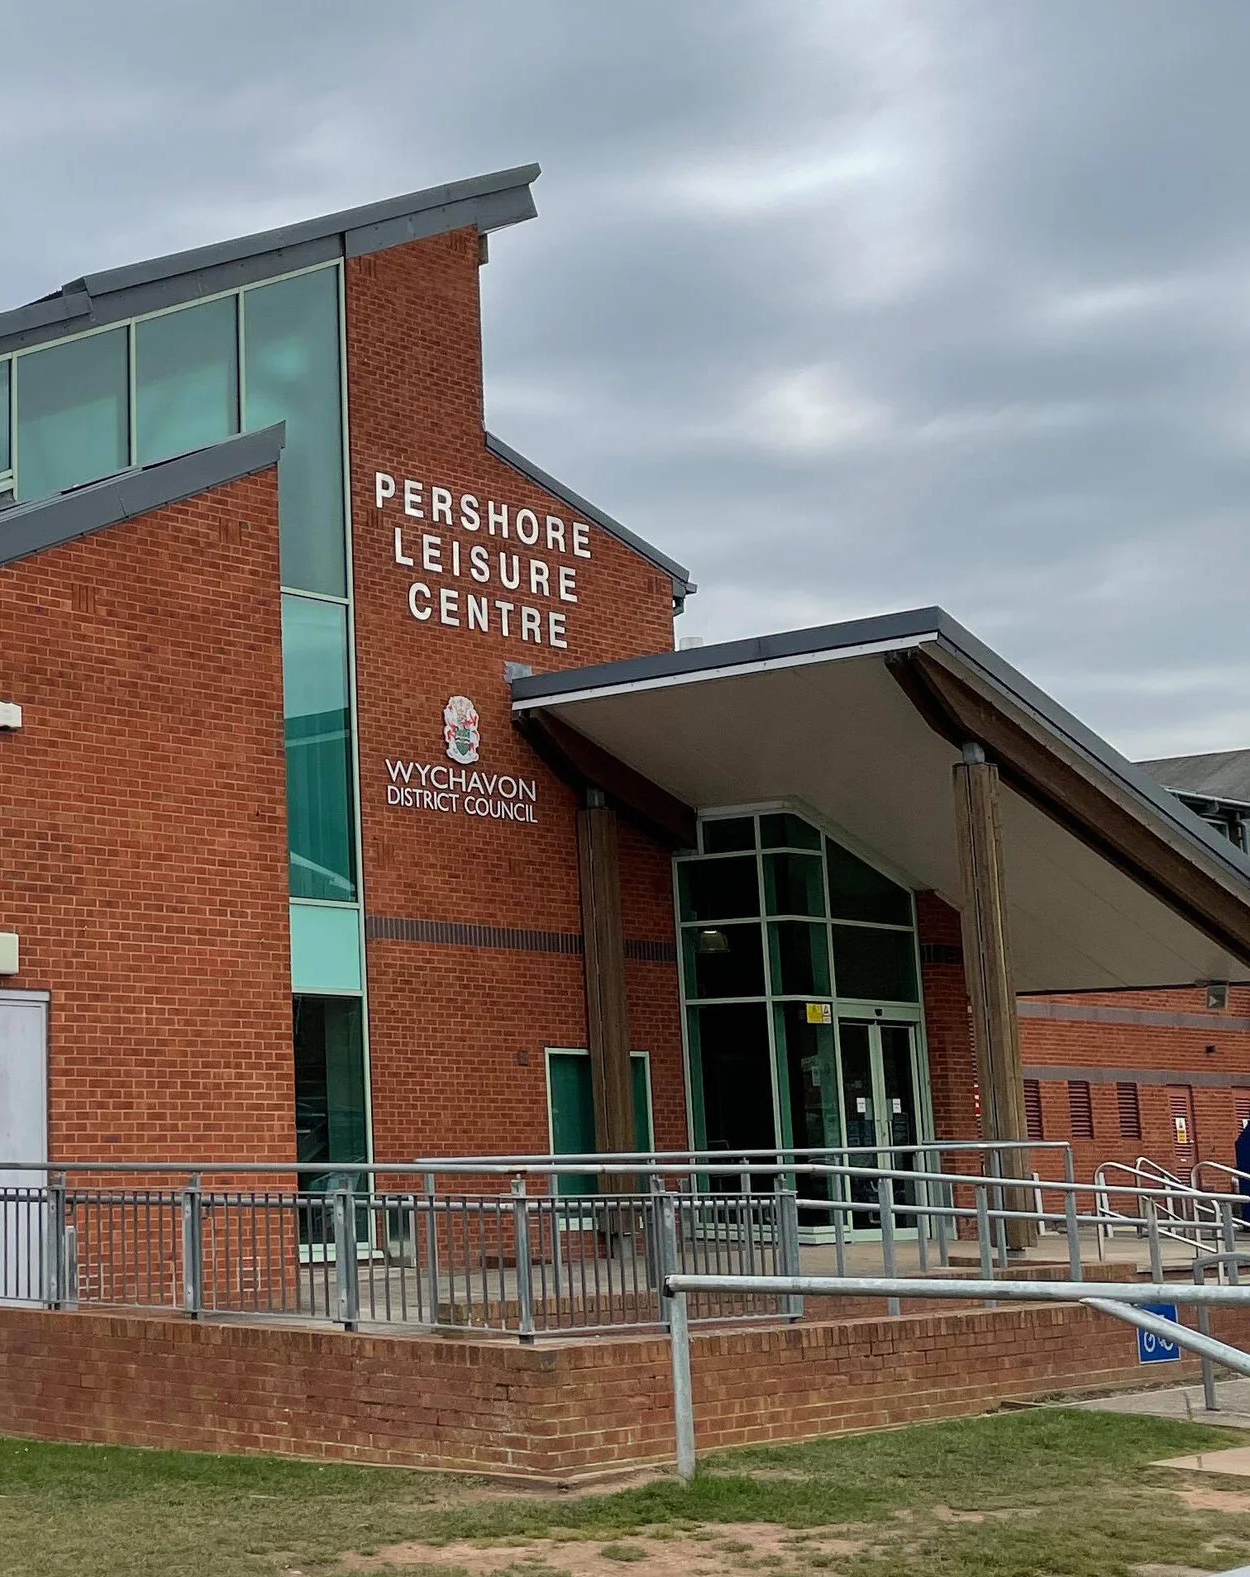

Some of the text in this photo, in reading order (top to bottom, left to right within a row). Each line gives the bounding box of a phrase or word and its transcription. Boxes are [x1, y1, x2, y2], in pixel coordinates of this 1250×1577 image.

[375, 471, 591, 559] PERSHORE
[394, 527, 578, 603] LEISURE
[408, 582, 568, 649] CENTRE
[385, 758, 537, 801] WYCHAVON
[387, 785, 538, 823] DISTRICT COUNCIL
